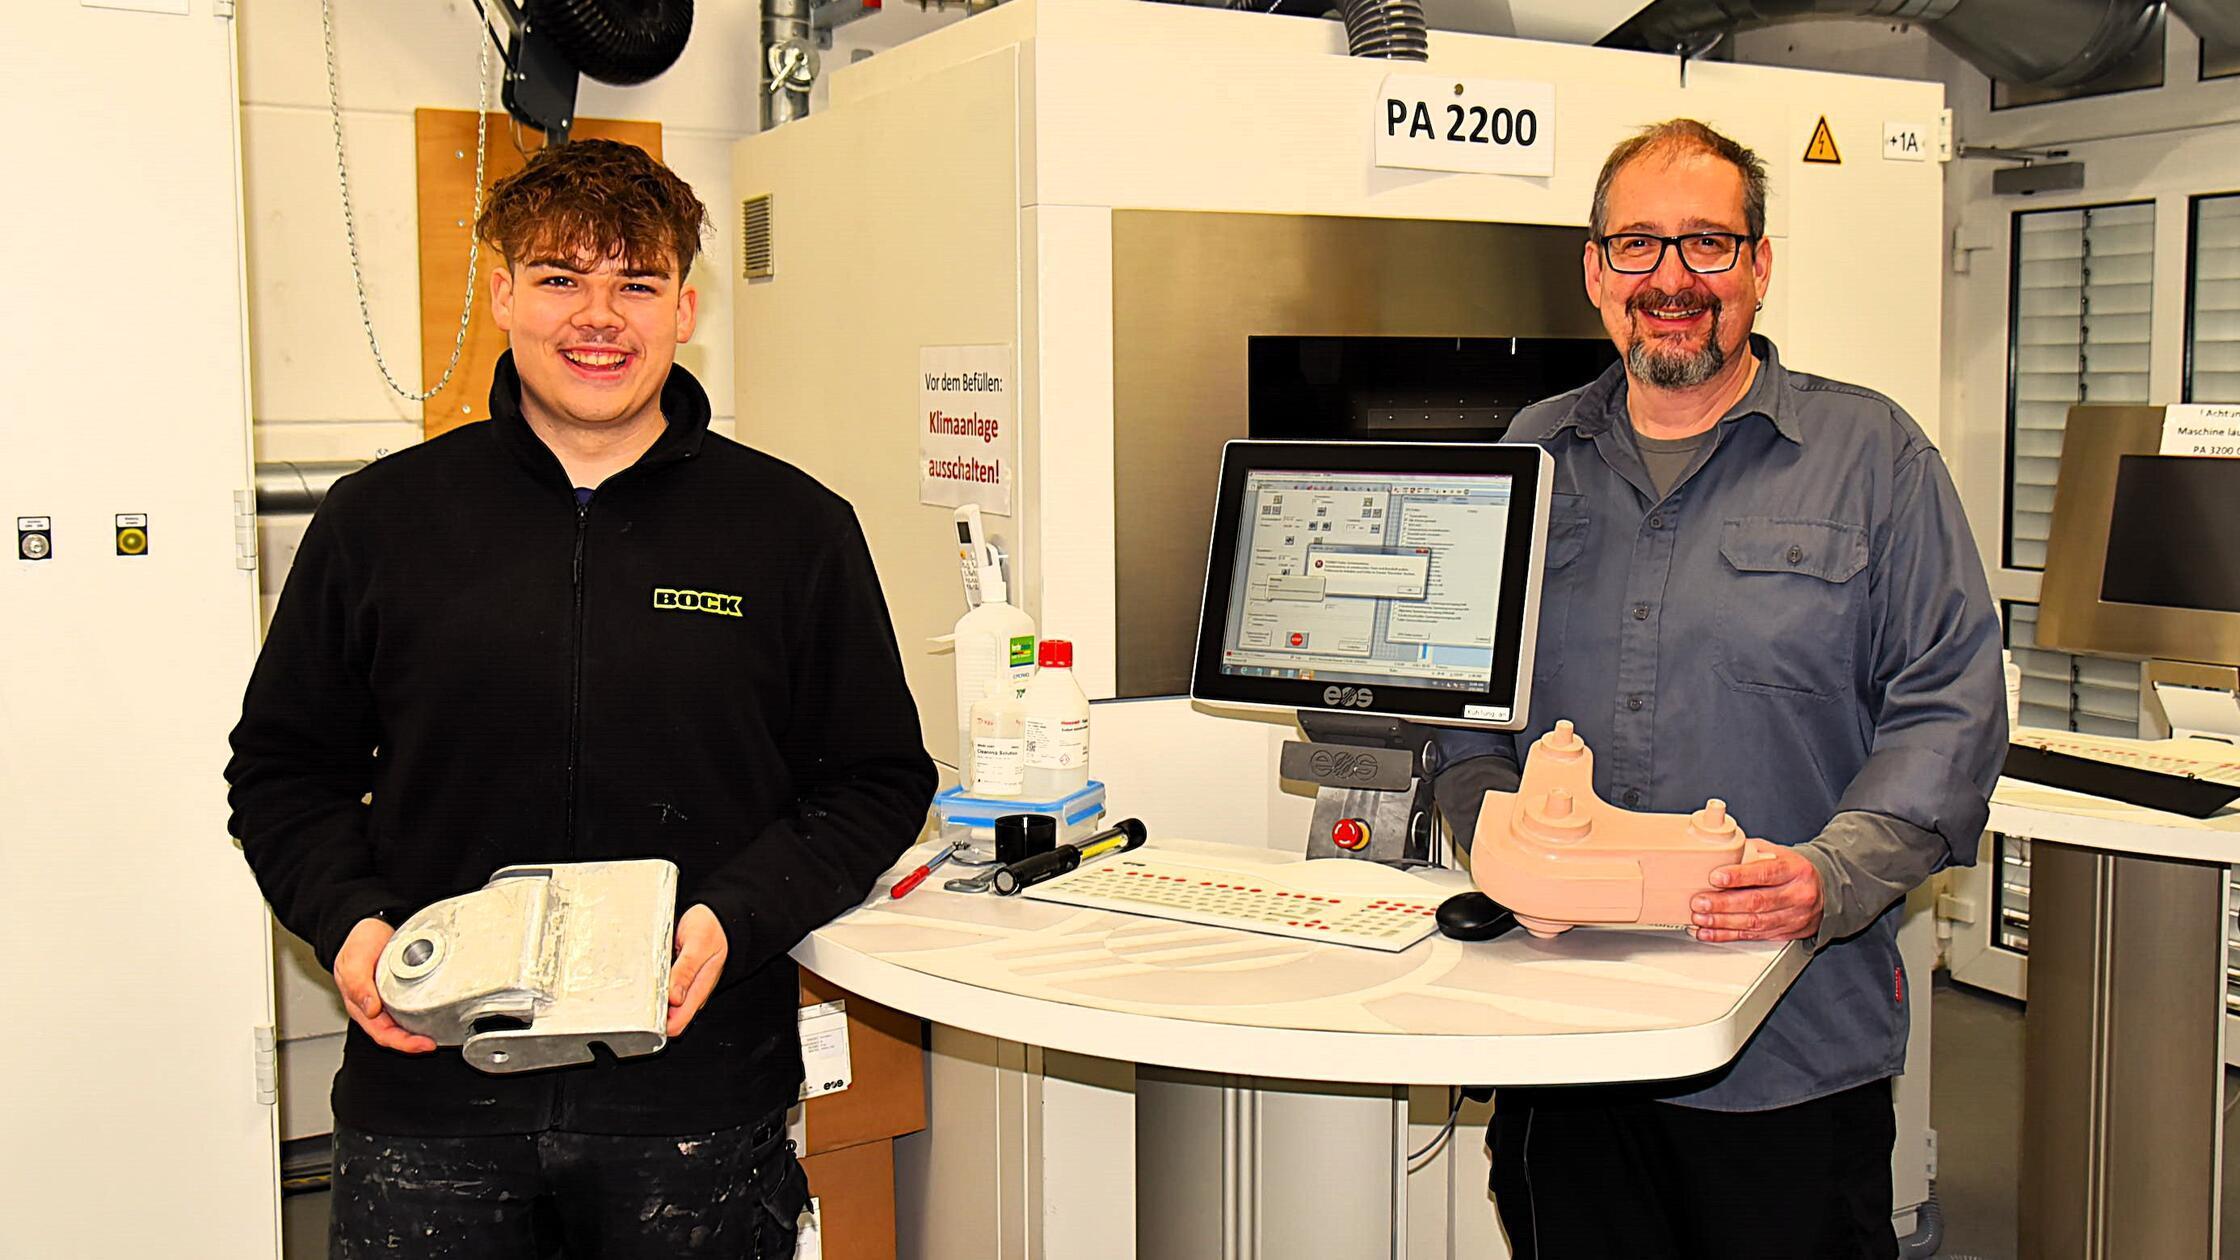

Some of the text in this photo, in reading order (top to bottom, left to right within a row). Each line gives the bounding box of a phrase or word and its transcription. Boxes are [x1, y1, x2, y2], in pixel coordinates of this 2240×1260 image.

[1387, 98, 1537, 147] PA 2200
[1889, 131, 1919, 153] +1A
[925, 372, 1003, 393] Vor dem Befüllen:
[929, 410, 999, 444] Klimaanlage
[2177, 427, 2225, 437] Maschine
[2193, 445, 2206, 453] PA
[2210, 446, 2234, 455] 3200
[928, 455, 1000, 485] ausschalten!
[653, 588, 744, 617] BOCK
[1323, 685, 1374, 708] eos
[1309, 749, 1379, 782] eos
